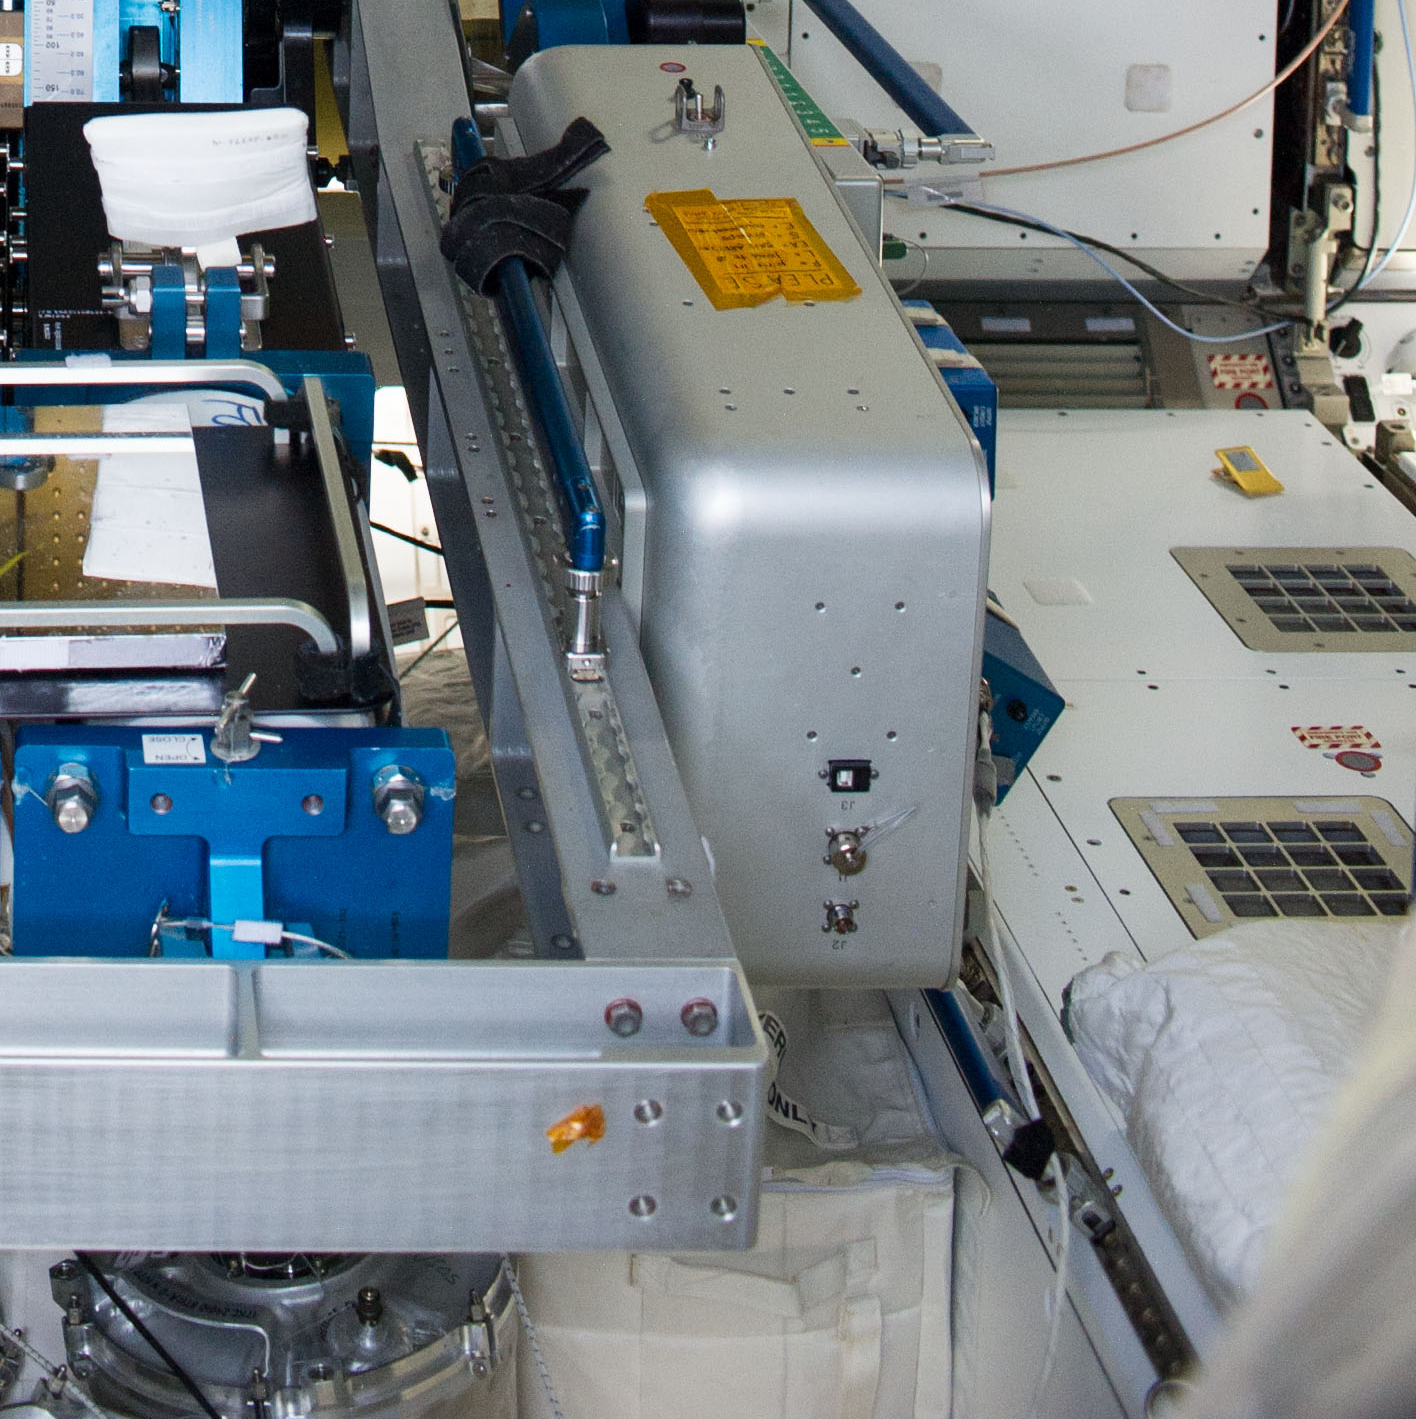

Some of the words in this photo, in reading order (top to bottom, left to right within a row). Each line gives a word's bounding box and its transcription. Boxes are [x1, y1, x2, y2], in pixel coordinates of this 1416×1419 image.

[45, 84, 60, 92] 150
[727, 273, 835, 289] PLEASE
[831, 939, 848, 951] J2
